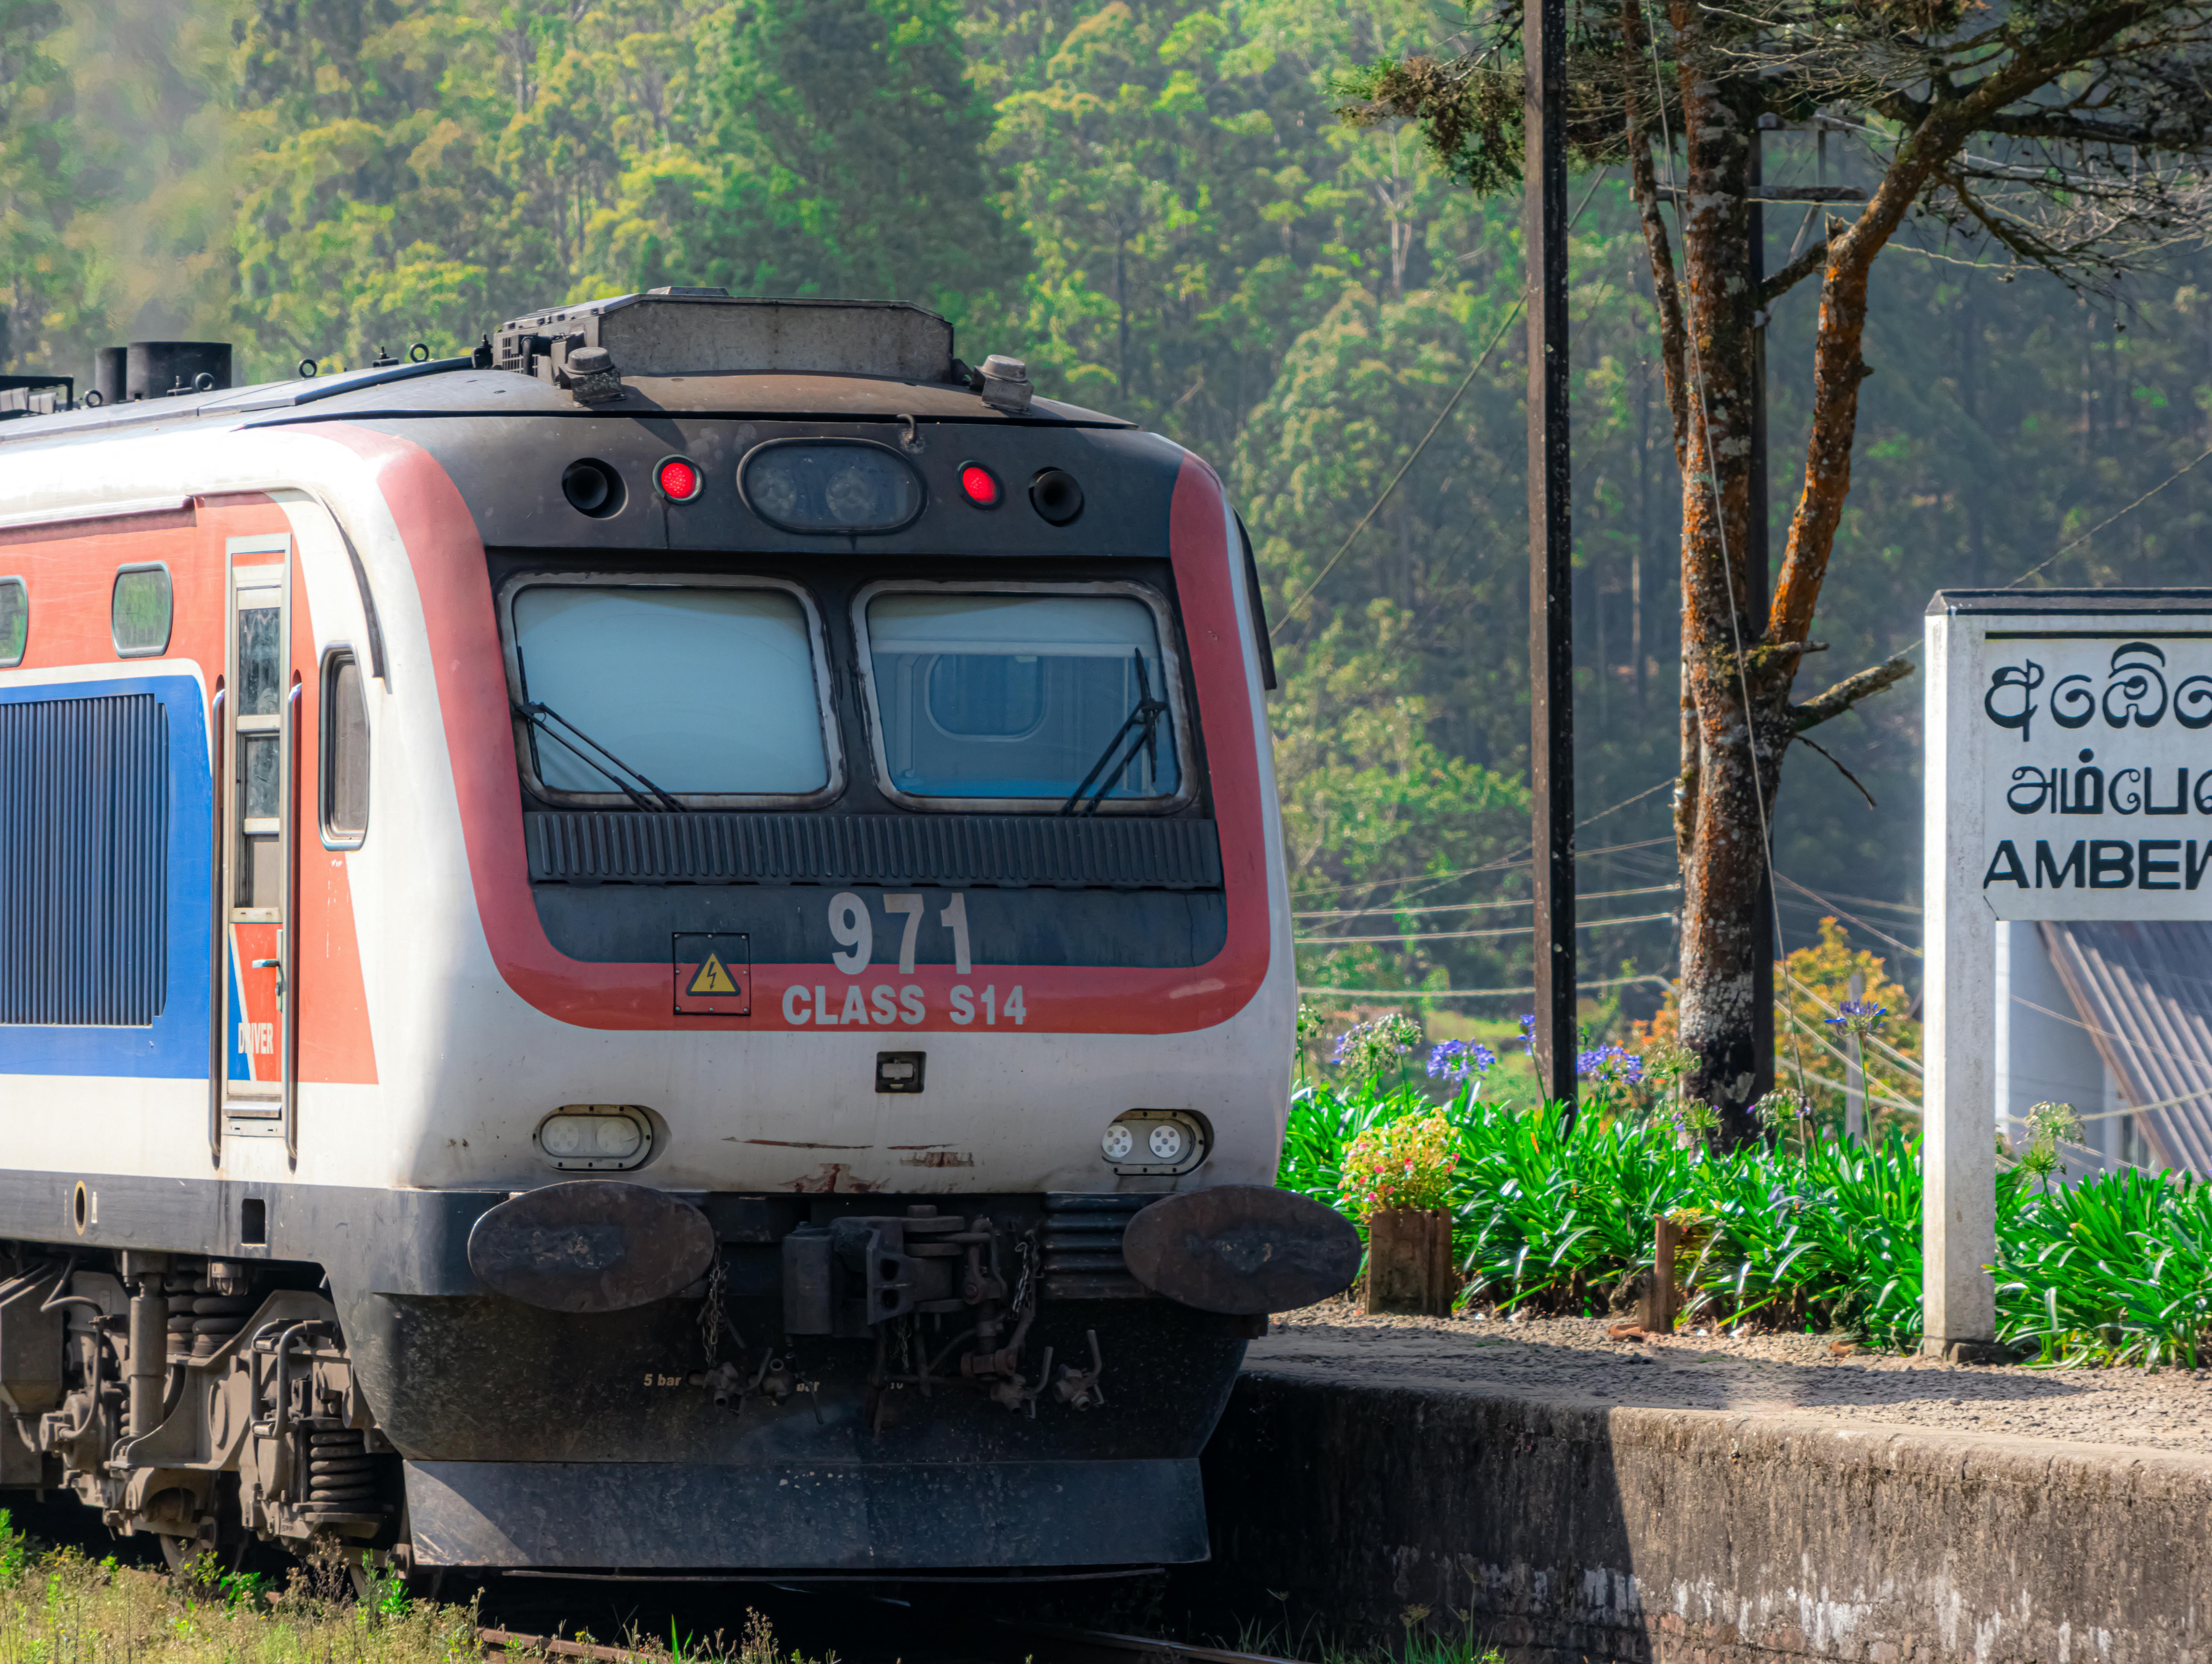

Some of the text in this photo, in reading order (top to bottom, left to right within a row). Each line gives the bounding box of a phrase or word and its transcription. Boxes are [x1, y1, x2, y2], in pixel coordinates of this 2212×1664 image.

[827, 892, 971, 975] 971
[782, 984, 1027, 1026] CLASS S14
[644, 1374, 681, 1386] 5 bar
